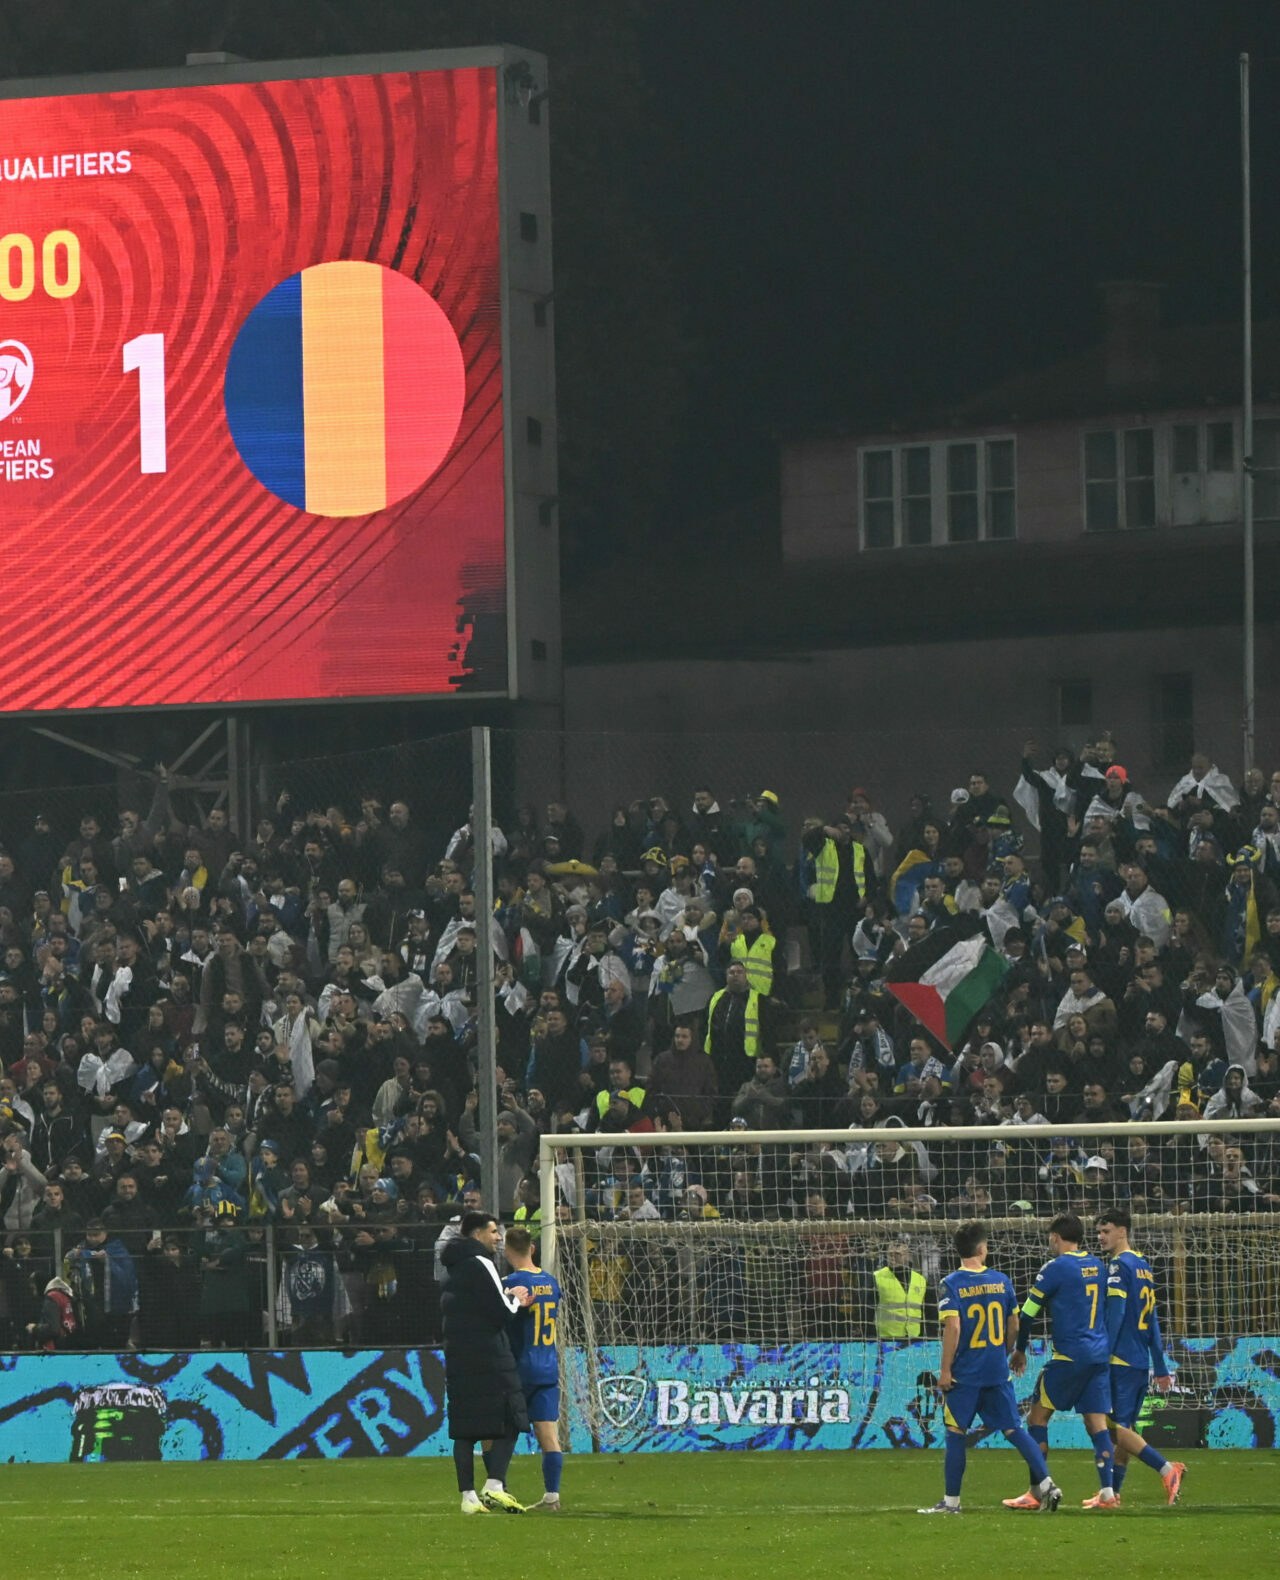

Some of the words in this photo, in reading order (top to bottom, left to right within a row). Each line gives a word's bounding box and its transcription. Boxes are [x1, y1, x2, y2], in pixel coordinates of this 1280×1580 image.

[123, 333, 167, 474] 1
[529, 1302, 556, 1346] 15
[967, 1301, 1004, 1348] 20
[1086, 1283, 1098, 1329] 7
[657, 1380, 851, 1425] Bavaria
